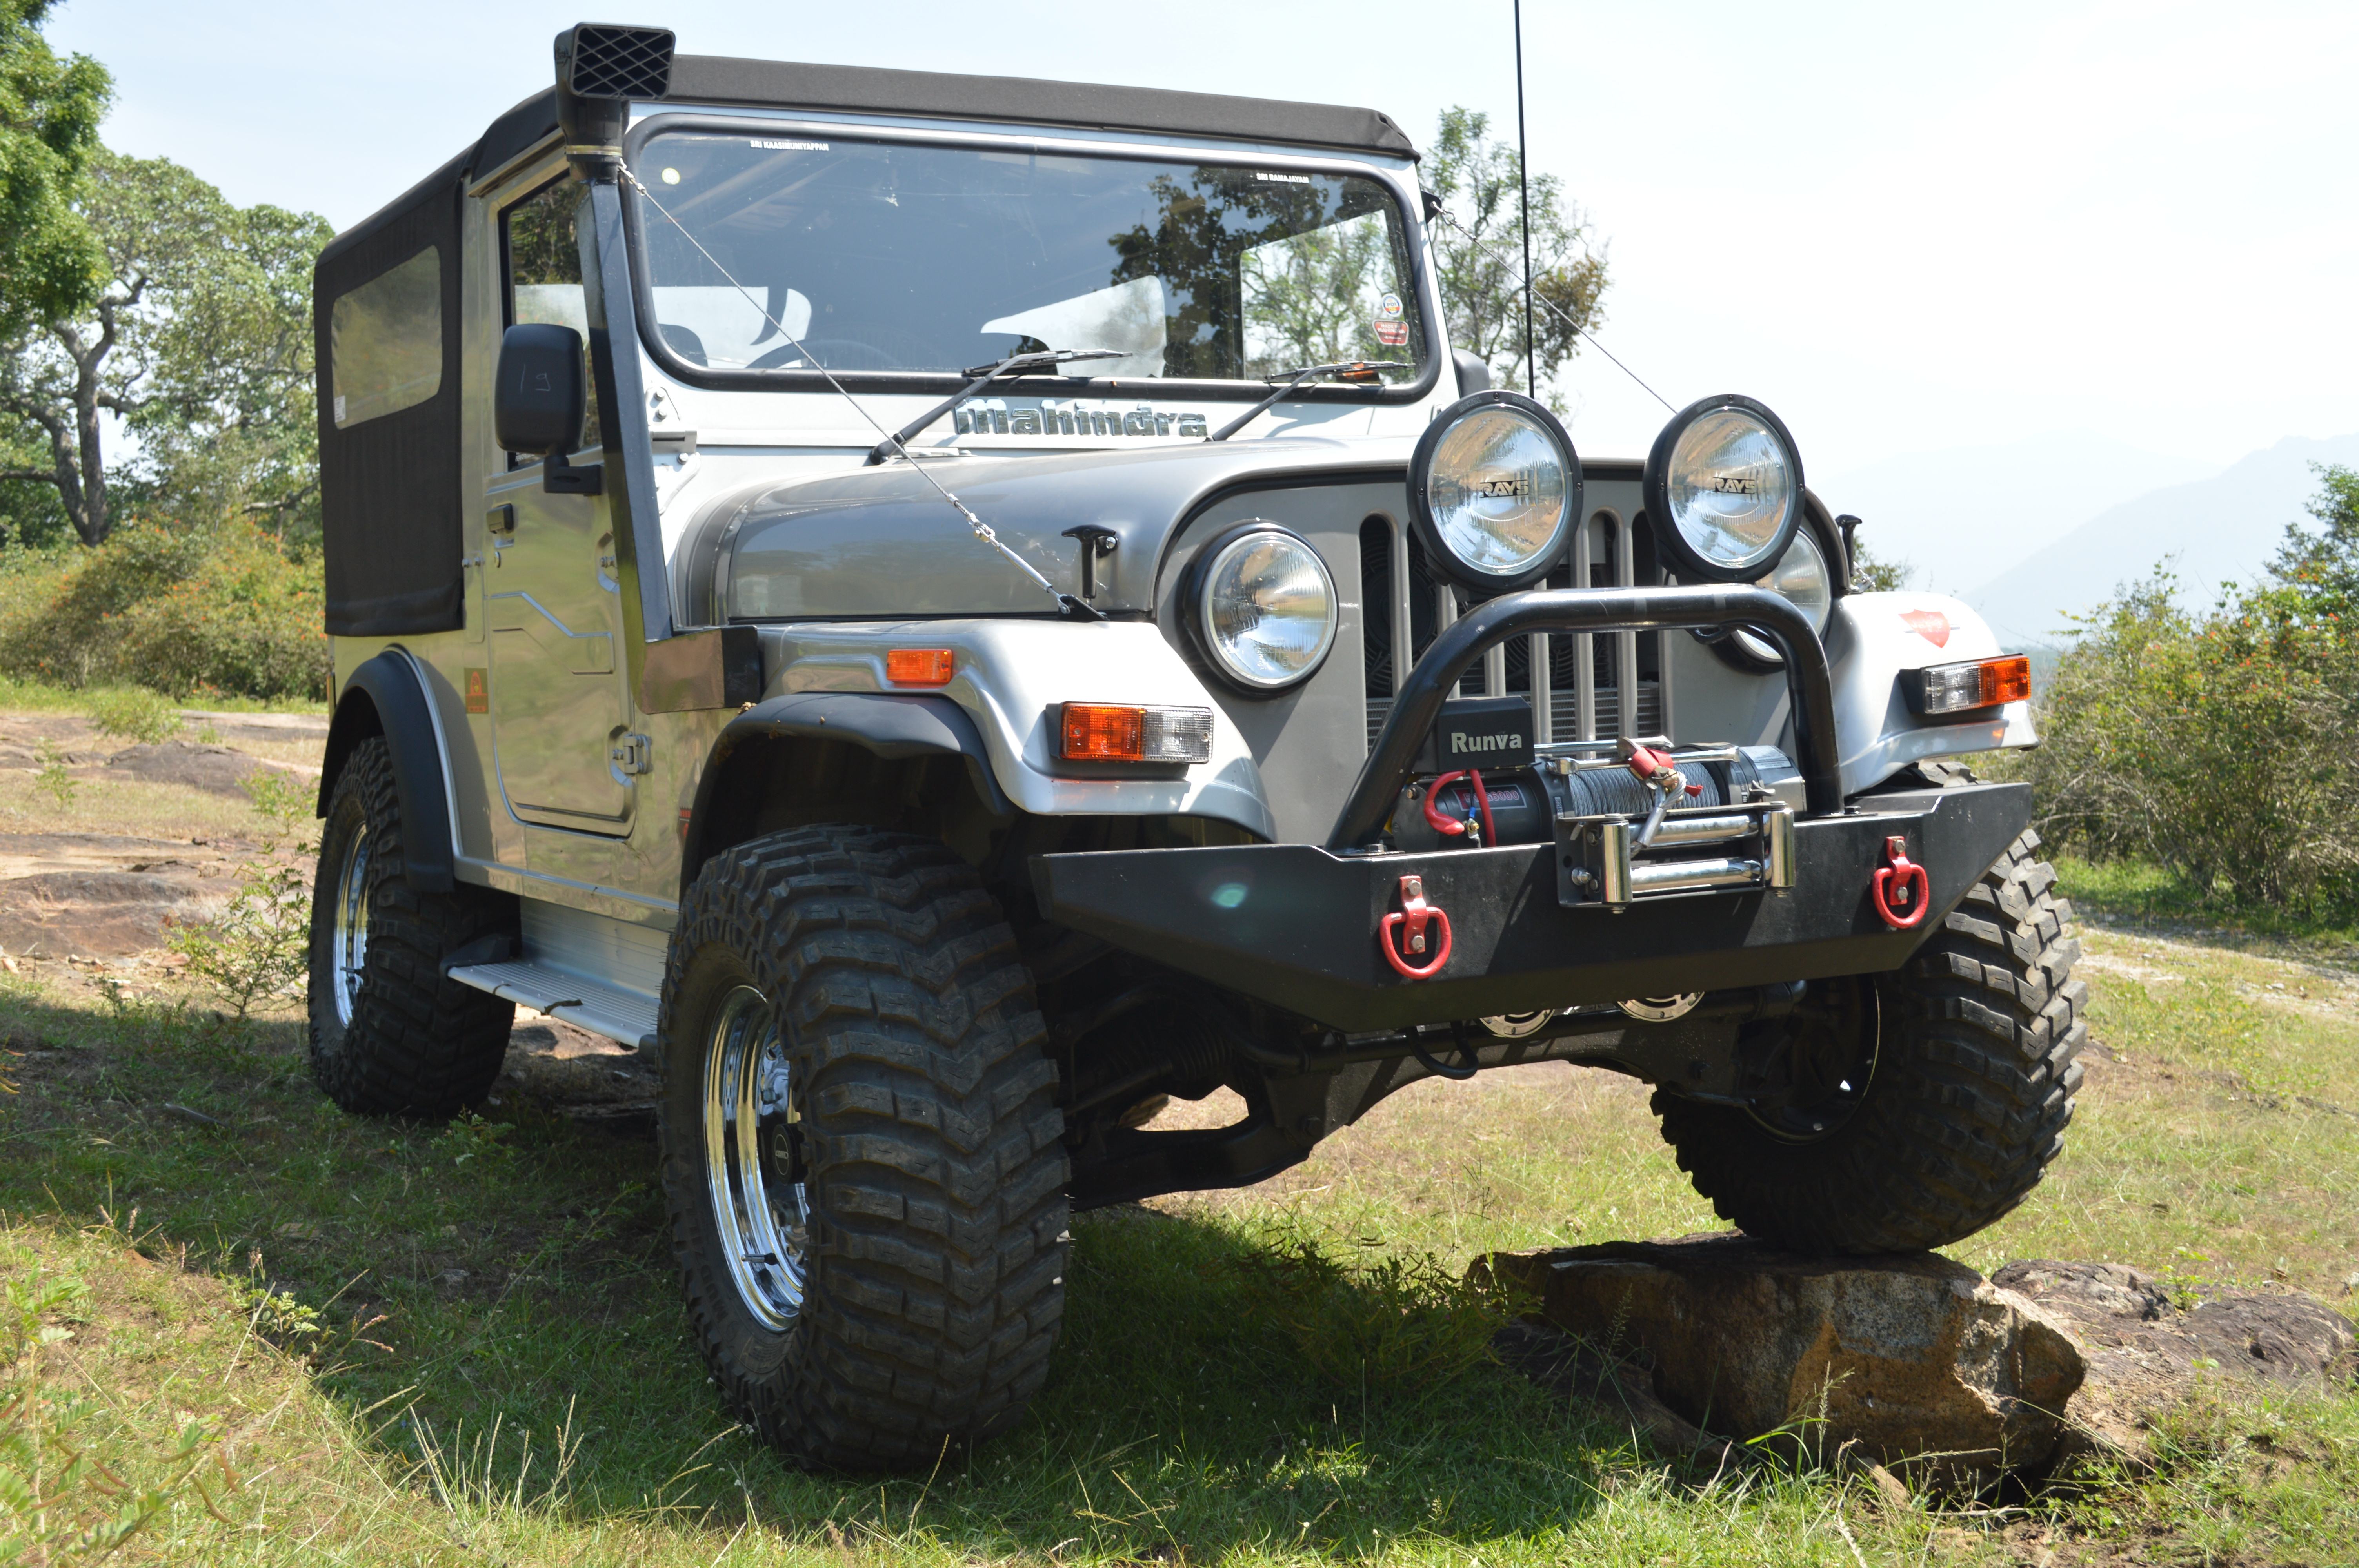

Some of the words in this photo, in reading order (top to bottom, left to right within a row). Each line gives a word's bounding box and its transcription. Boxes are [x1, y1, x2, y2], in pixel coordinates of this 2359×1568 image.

[750, 140, 762, 149] SRI
[1479, 480, 1528, 498] RAYS
[1712, 477, 1755, 494] RAYS
[1451, 732, 1522, 753] Runva
